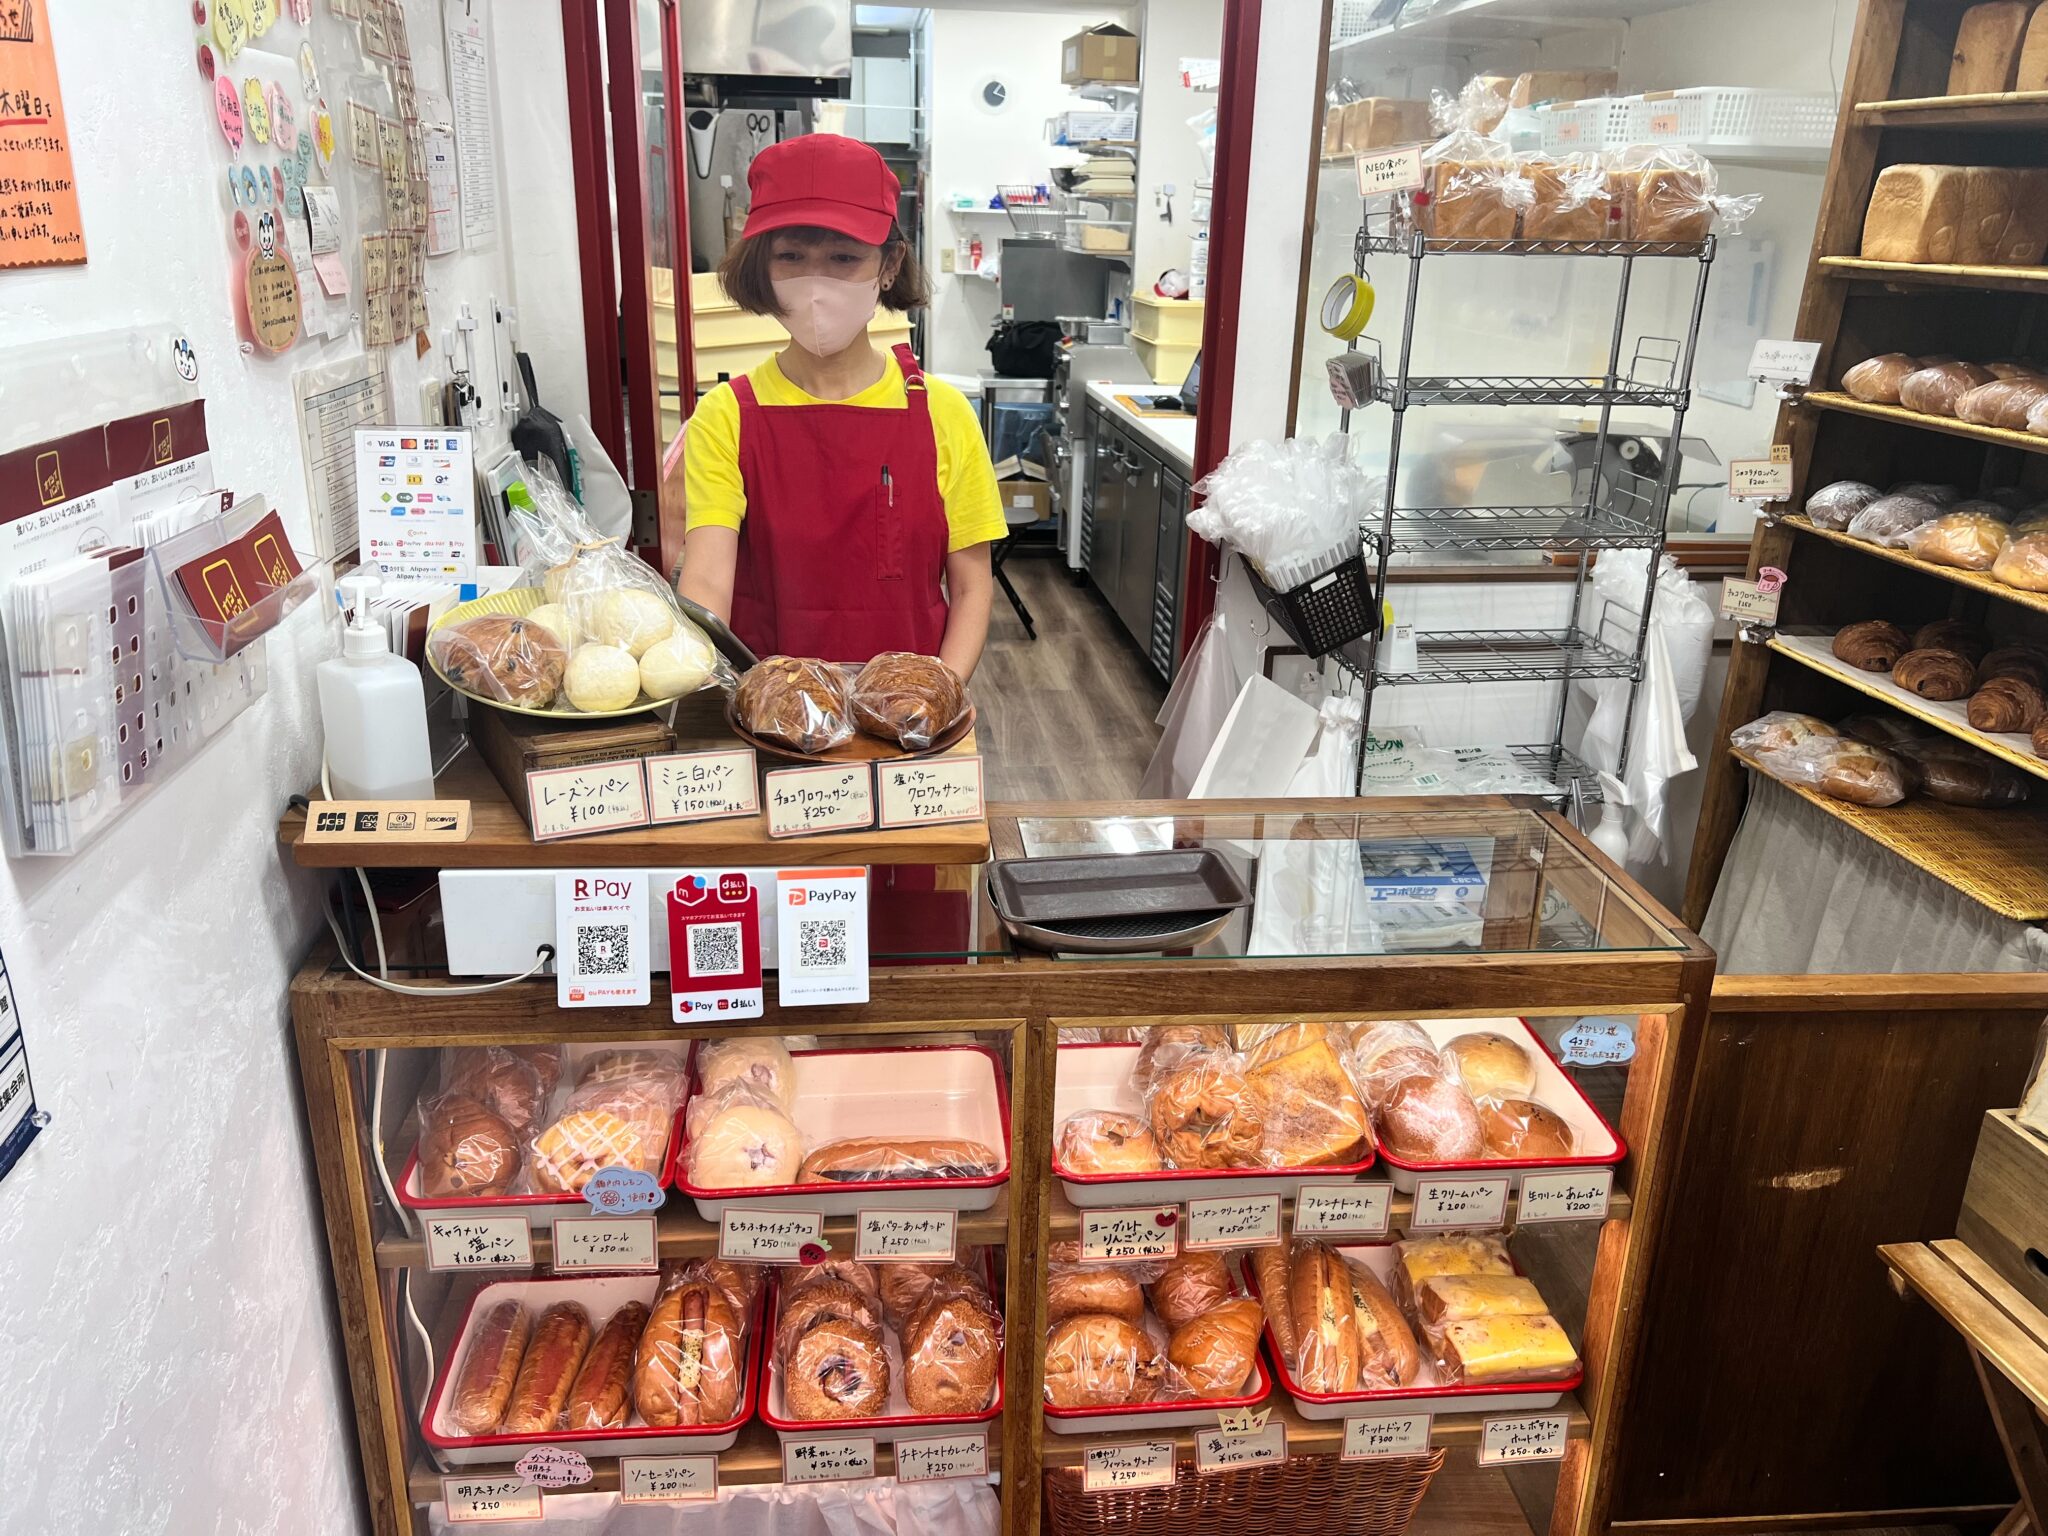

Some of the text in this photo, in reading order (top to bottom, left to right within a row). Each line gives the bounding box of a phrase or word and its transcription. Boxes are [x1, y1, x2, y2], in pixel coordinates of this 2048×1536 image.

[377, 440, 395, 448] VISA
[663, 764, 735, 785] ミニ白パン
[894, 770, 936, 786] 塩バター
[543, 777, 630, 806] レーズンパン
[774, 788, 849, 806] チョコクロワッサン
[908, 783, 961, 802] クロワッサン
[570, 804, 605, 823] ¥100
[914, 804, 943, 817] ¥220
[595, 879, 632, 899] Pay
[1371, 887, 1438, 901] エコポリテック
[809, 889, 857, 903] PayPay
[695, 1001, 713, 1011] Pay
[1428, 1187, 1494, 1200] 生クリームパン
[1308, 1198, 1373, 1210] フレンチトースト
[1438, 1203, 1466, 1212] ¥200
[1566, 1202, 1591, 1211] ¥200
[1319, 1212, 1348, 1222] ¥200
[433, 1225, 489, 1238] キャラメル
[867, 1219, 947, 1233] 塩バターあんサンド
[1089, 1220, 1142, 1233] ヨーグルト
[573, 1232, 629, 1243] レモンロール
[882, 1236, 909, 1247] ¥250
[1103, 1230, 1166, 1244] りんごパン
[468, 1236, 514, 1253] 塩パン
[1370, 1435, 1393, 1446] ¥300
[632, 1469, 696, 1481] ソーセージパン
[1112, 1471, 1137, 1481] ¥250
[458, 1484, 522, 1497] 明太子パン
[651, 1482, 677, 1491] ¥200
[472, 1501, 500, 1511] ¥250
